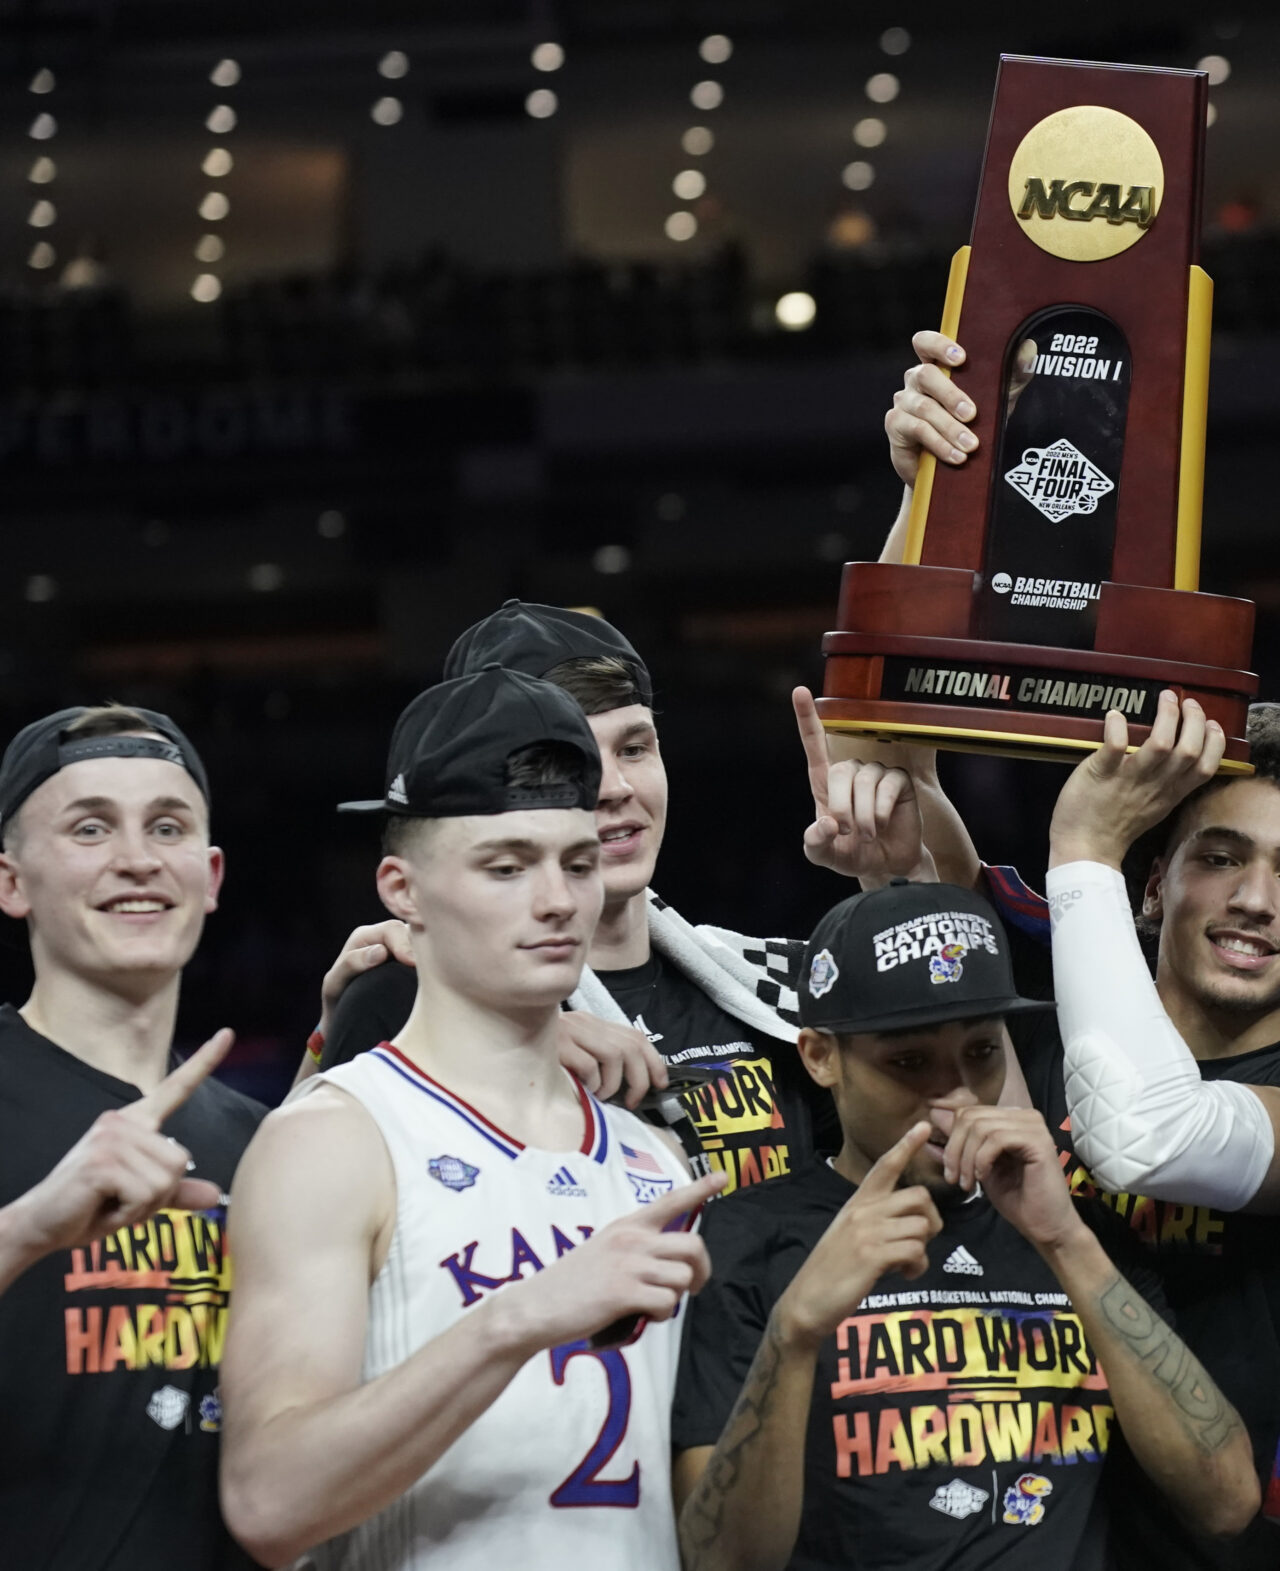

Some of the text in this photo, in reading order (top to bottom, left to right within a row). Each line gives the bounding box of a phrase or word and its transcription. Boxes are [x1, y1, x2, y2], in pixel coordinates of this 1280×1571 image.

[1017, 176, 1156, 230] NCAA
[1050, 333, 1099, 355] 2022
[1112, 361, 1123, 382] I
[1038, 458, 1087, 480] FINAL
[1032, 477, 1084, 500] FOUR
[1051, 503, 1076, 511] ORLEANS
[1010, 593, 1089, 611] CHAMPIONSHIP
[904, 667, 1147, 715] NATIONAL CHAMPION
[875, 919, 997, 957] NATIONAL
[877, 932, 1000, 972] CHAMPS
[670, 1045, 714, 1064] NATIONAL
[943, 1262, 984, 1276] adidas
[930, 1290, 990, 1304] BASKETBALL
[989, 1291, 1035, 1306] NATIONAL
[836, 1318, 967, 1382] HARD
[549, 1338, 640, 1508] 2
